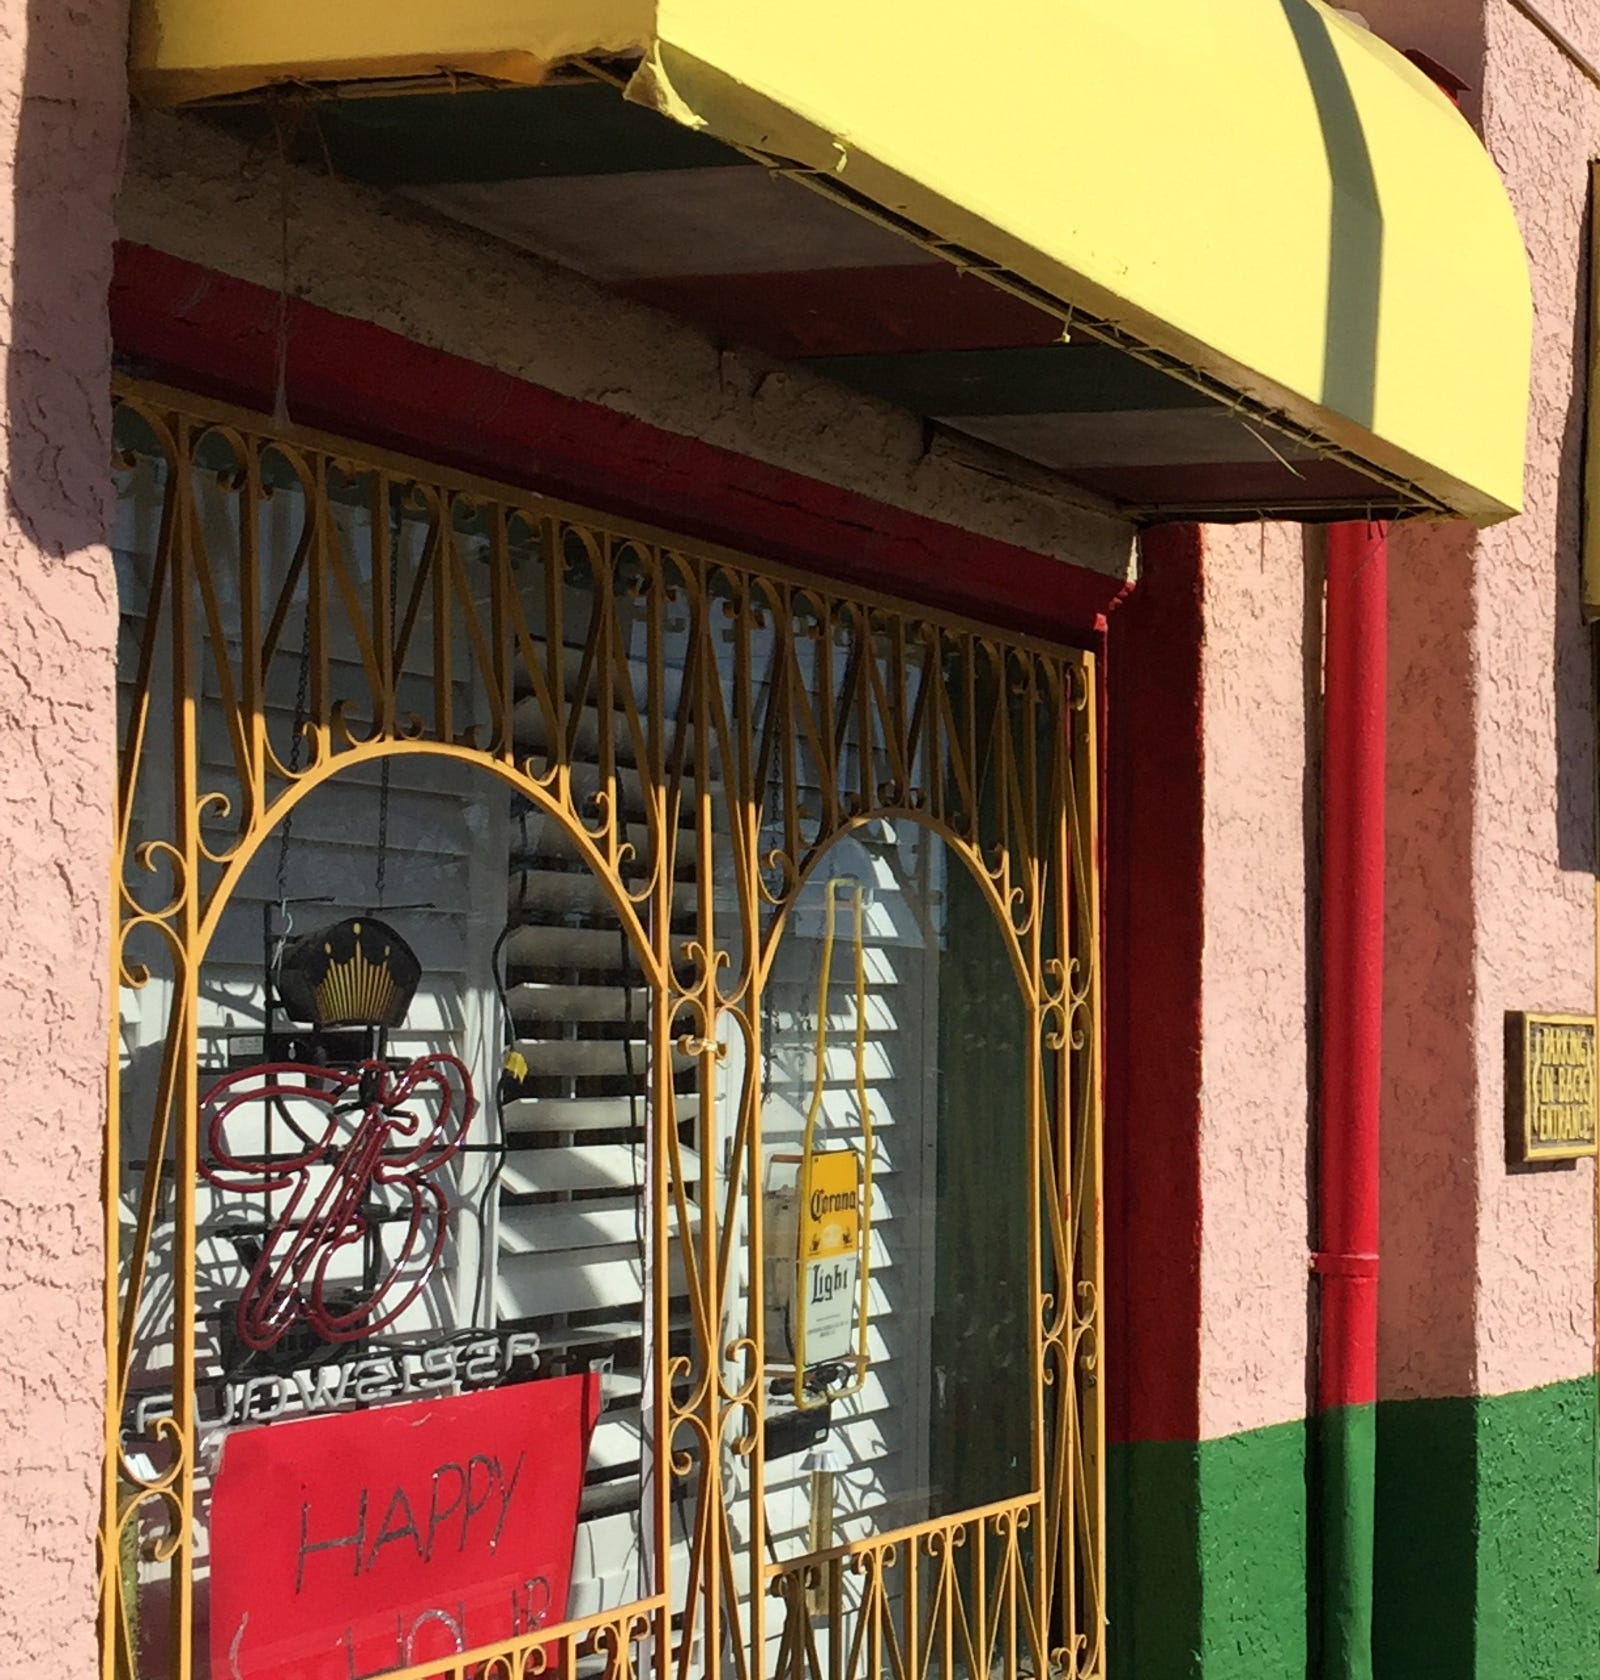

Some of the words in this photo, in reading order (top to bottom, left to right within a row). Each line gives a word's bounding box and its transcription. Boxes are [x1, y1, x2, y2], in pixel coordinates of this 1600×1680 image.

[1541, 1066, 1554, 1103] IN
[1558, 1066, 1589, 1103] BACK
[810, 1188, 857, 1223] Corona
[811, 1263, 849, 1305] Light
[295, 1451, 525, 1595] HAPPY
